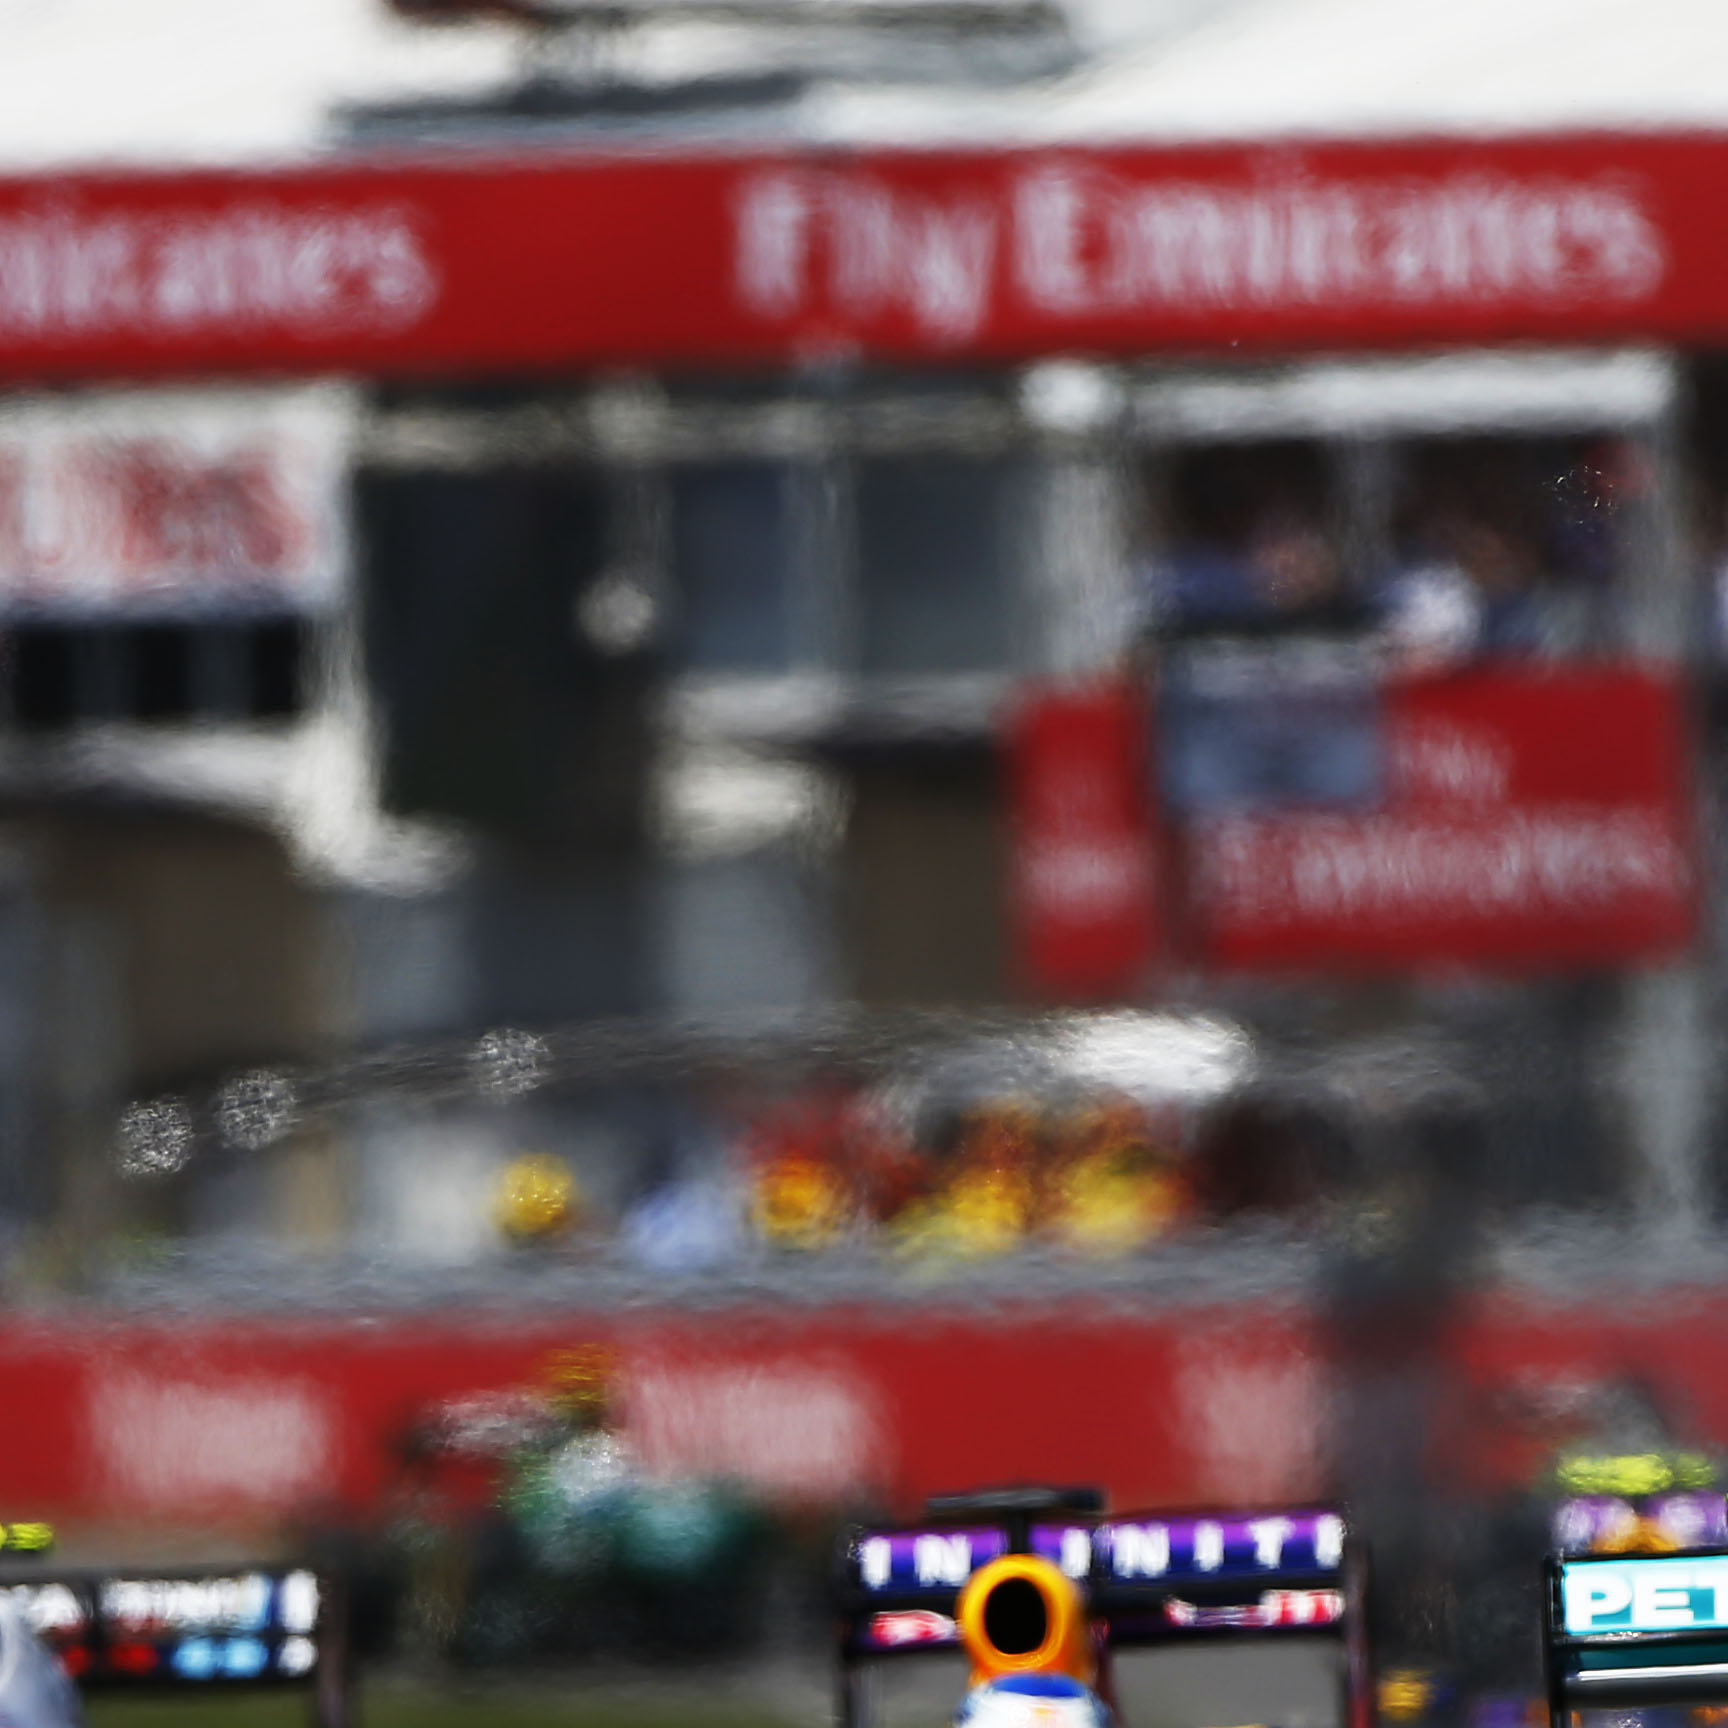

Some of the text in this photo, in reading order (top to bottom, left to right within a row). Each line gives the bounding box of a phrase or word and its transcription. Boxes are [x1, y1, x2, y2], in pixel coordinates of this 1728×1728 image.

[732, 158, 1667, 342] Fly Emirates
[860, 1514, 1344, 1590] ININITI
